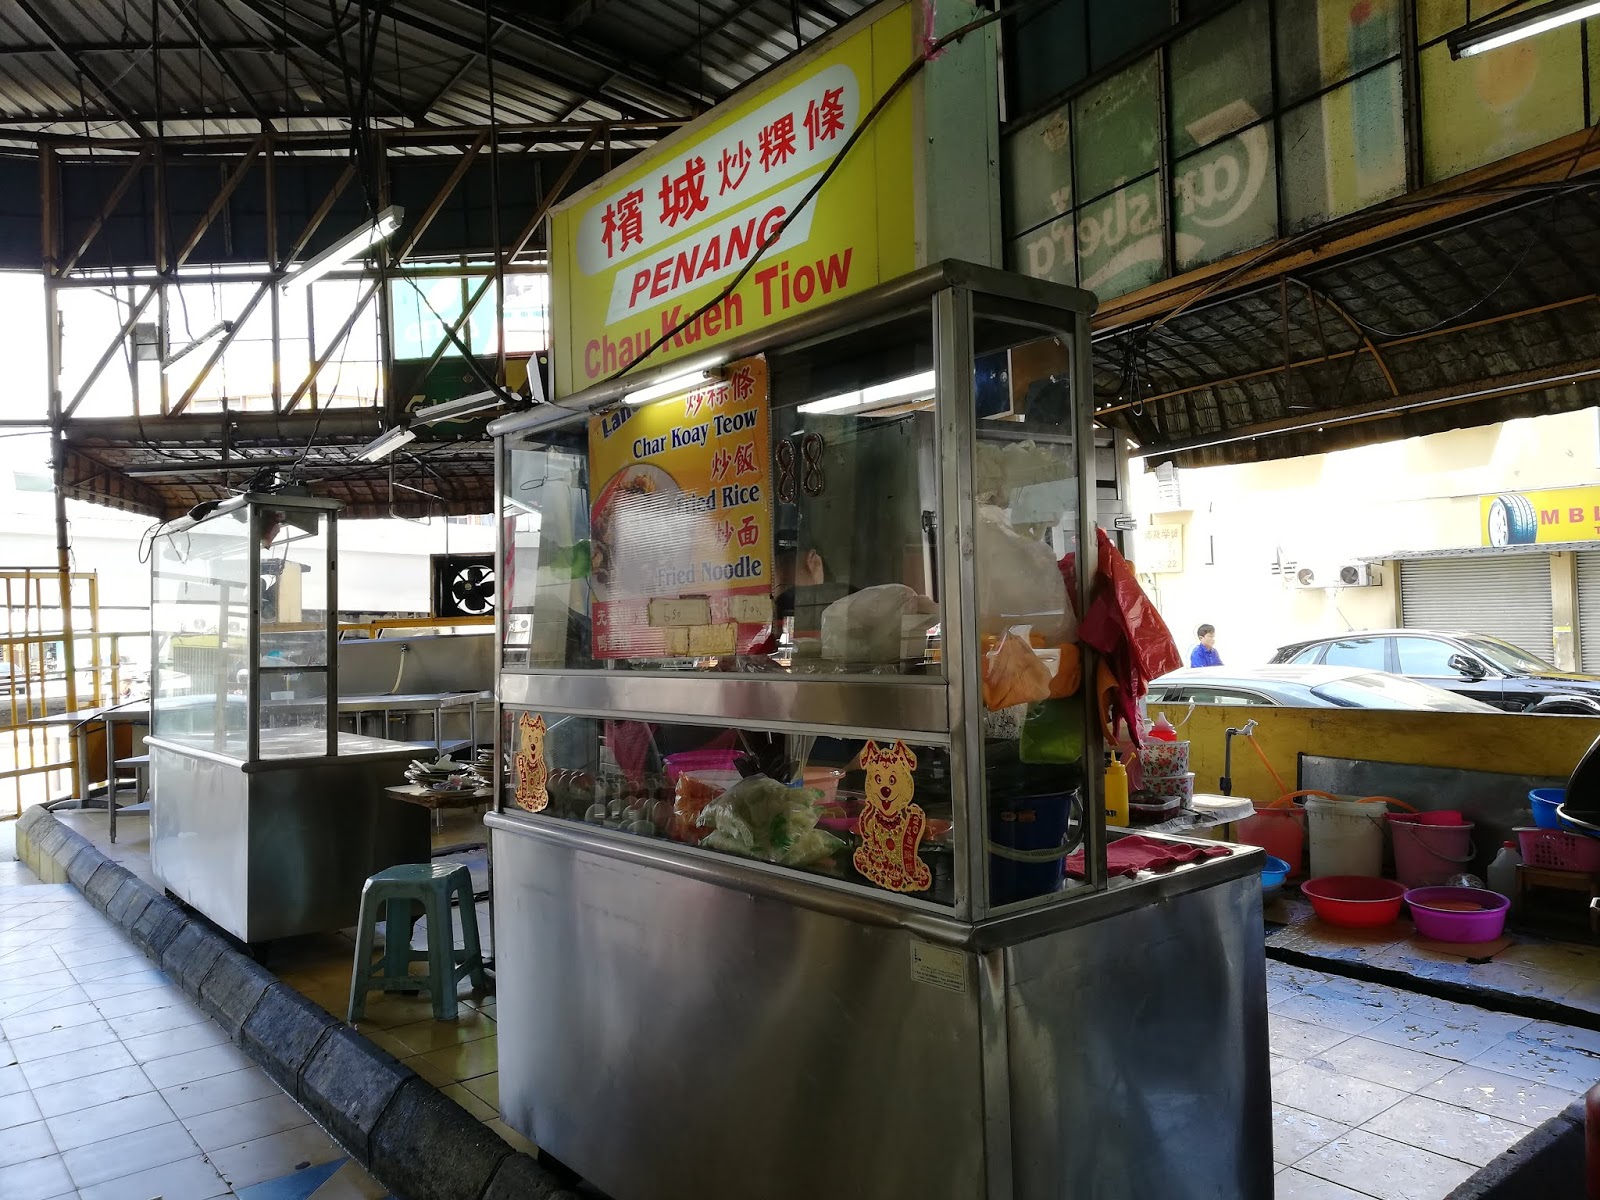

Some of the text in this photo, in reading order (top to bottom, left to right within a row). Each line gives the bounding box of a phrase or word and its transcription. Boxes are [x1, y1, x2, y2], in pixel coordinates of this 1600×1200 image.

[600, 86, 845, 259] 檳城炒粿條
[628, 205, 787, 309] PENANG
[584, 247, 853, 379] Chau Kueh Tiow
[601, 407, 641, 439] Lan
[633, 409, 758, 458] Char Koay Teow
[711, 443, 757, 480] 炒飯
[722, 484, 759, 508] Rice
[657, 555, 762, 586] Fried Noodle
